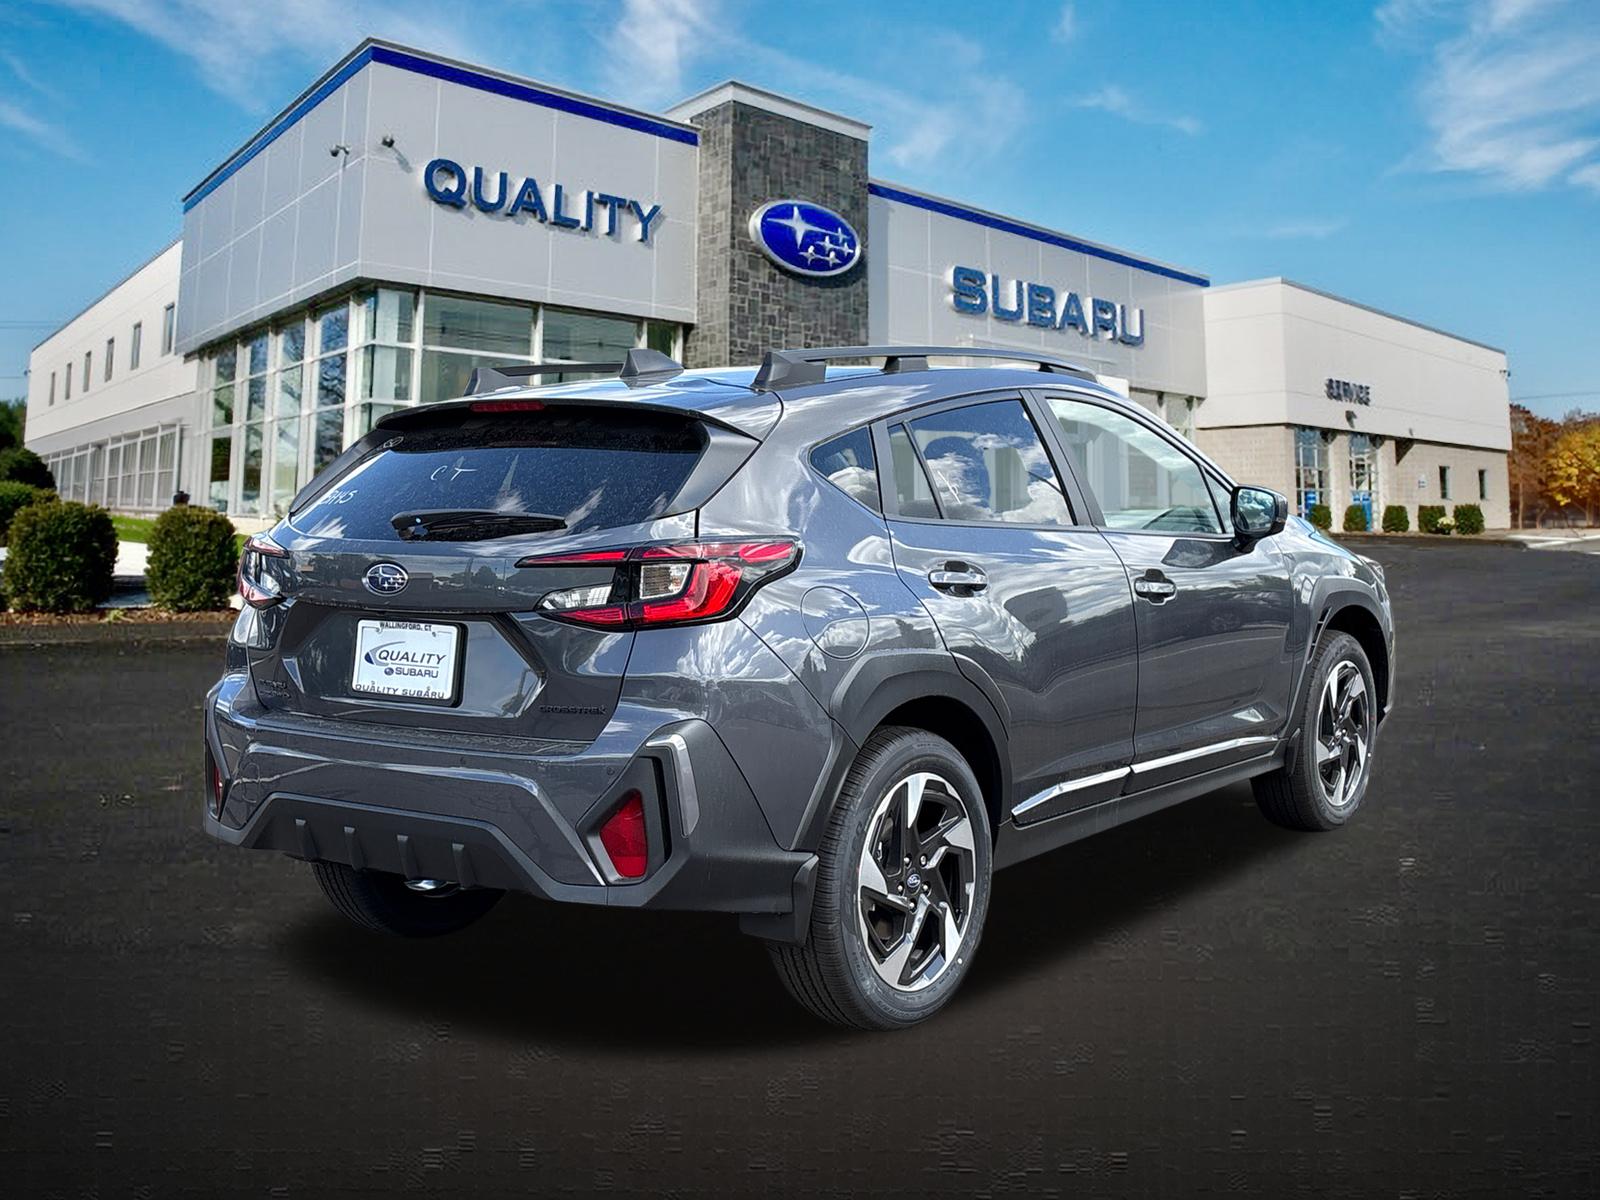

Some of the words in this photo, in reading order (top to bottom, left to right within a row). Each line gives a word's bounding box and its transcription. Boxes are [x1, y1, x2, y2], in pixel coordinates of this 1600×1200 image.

[424, 158, 661, 242] QUALITY
[951, 265, 1144, 346] SUBARU
[378, 649, 447, 665] QUALITY
[395, 667, 439, 678] SUBARU
[355, 683, 399, 695] QUALITY
[401, 688, 445, 699] SUBARU
